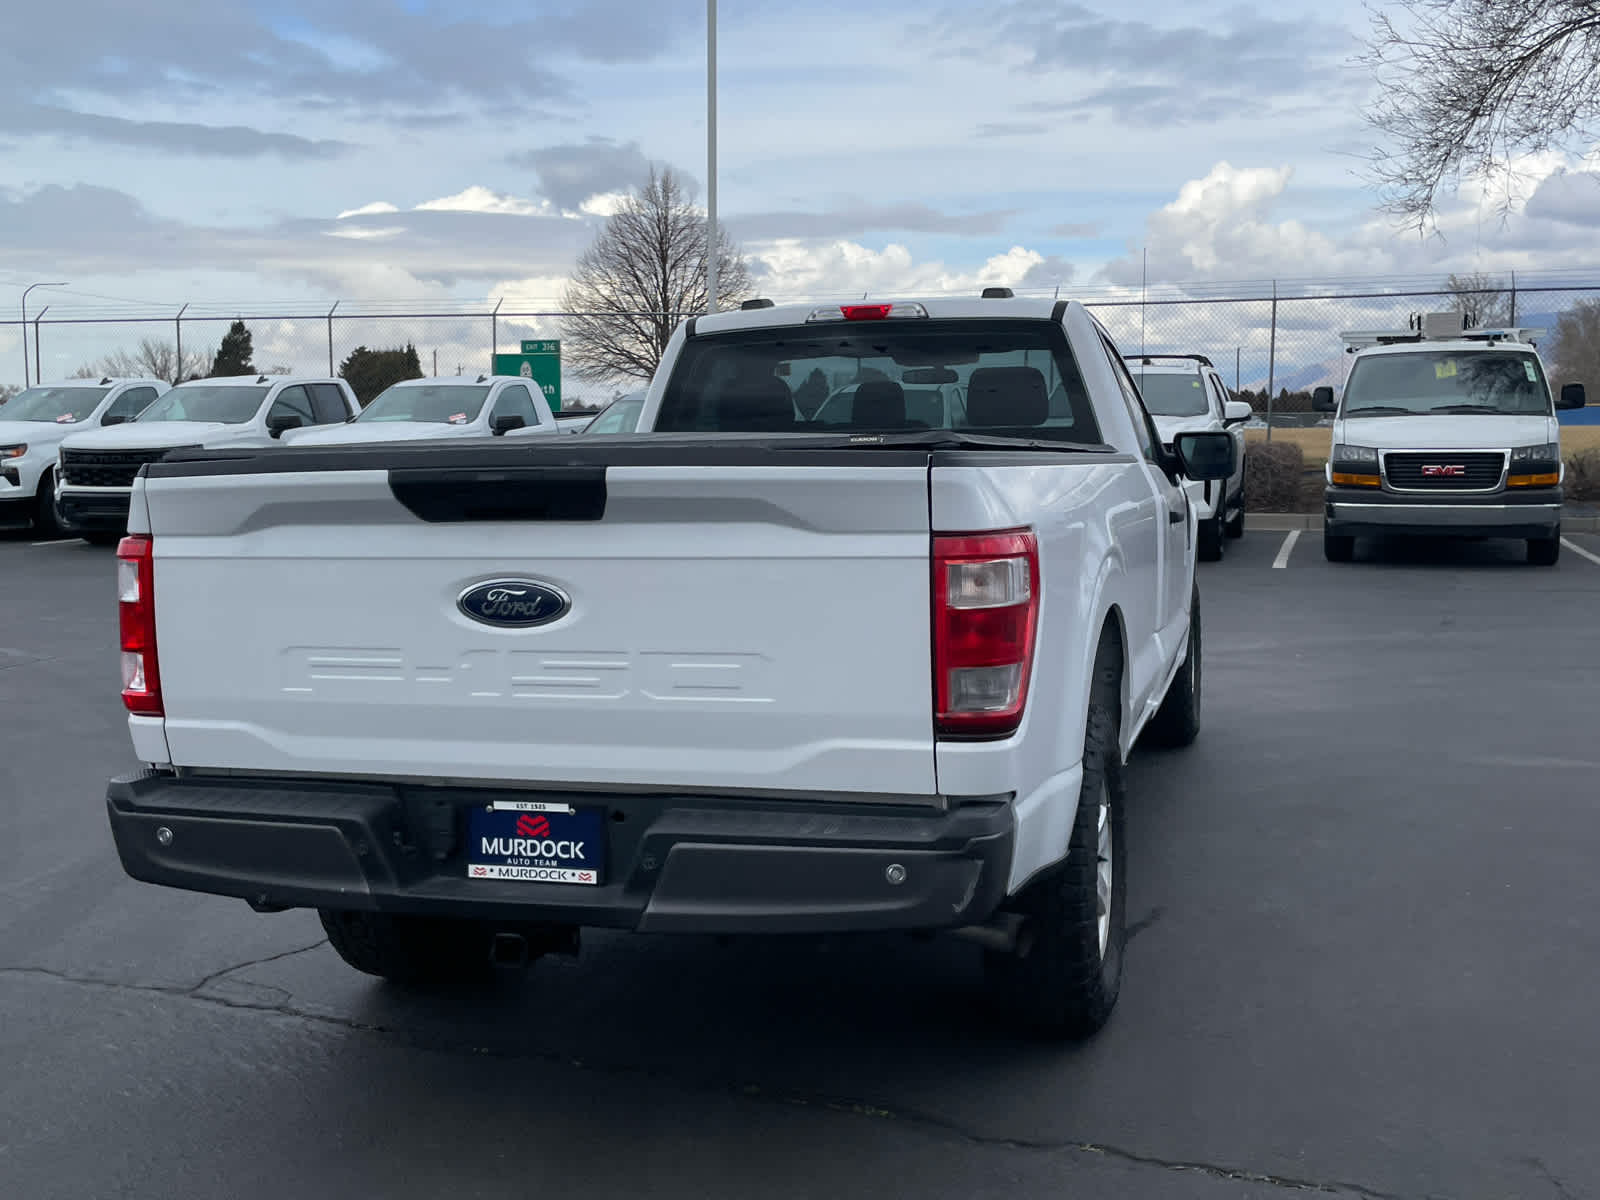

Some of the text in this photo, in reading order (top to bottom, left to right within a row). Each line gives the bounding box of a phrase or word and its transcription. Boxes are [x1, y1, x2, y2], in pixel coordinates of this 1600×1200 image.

[525, 342, 556, 351] EXIT 316
[1421, 464, 1465, 476] GMC
[481, 588, 542, 616] Ford
[482, 837, 585, 859] MURDOCK
[507, 858, 558, 867] AUTO TEAM
[498, 867, 567, 881] MURDOCK
